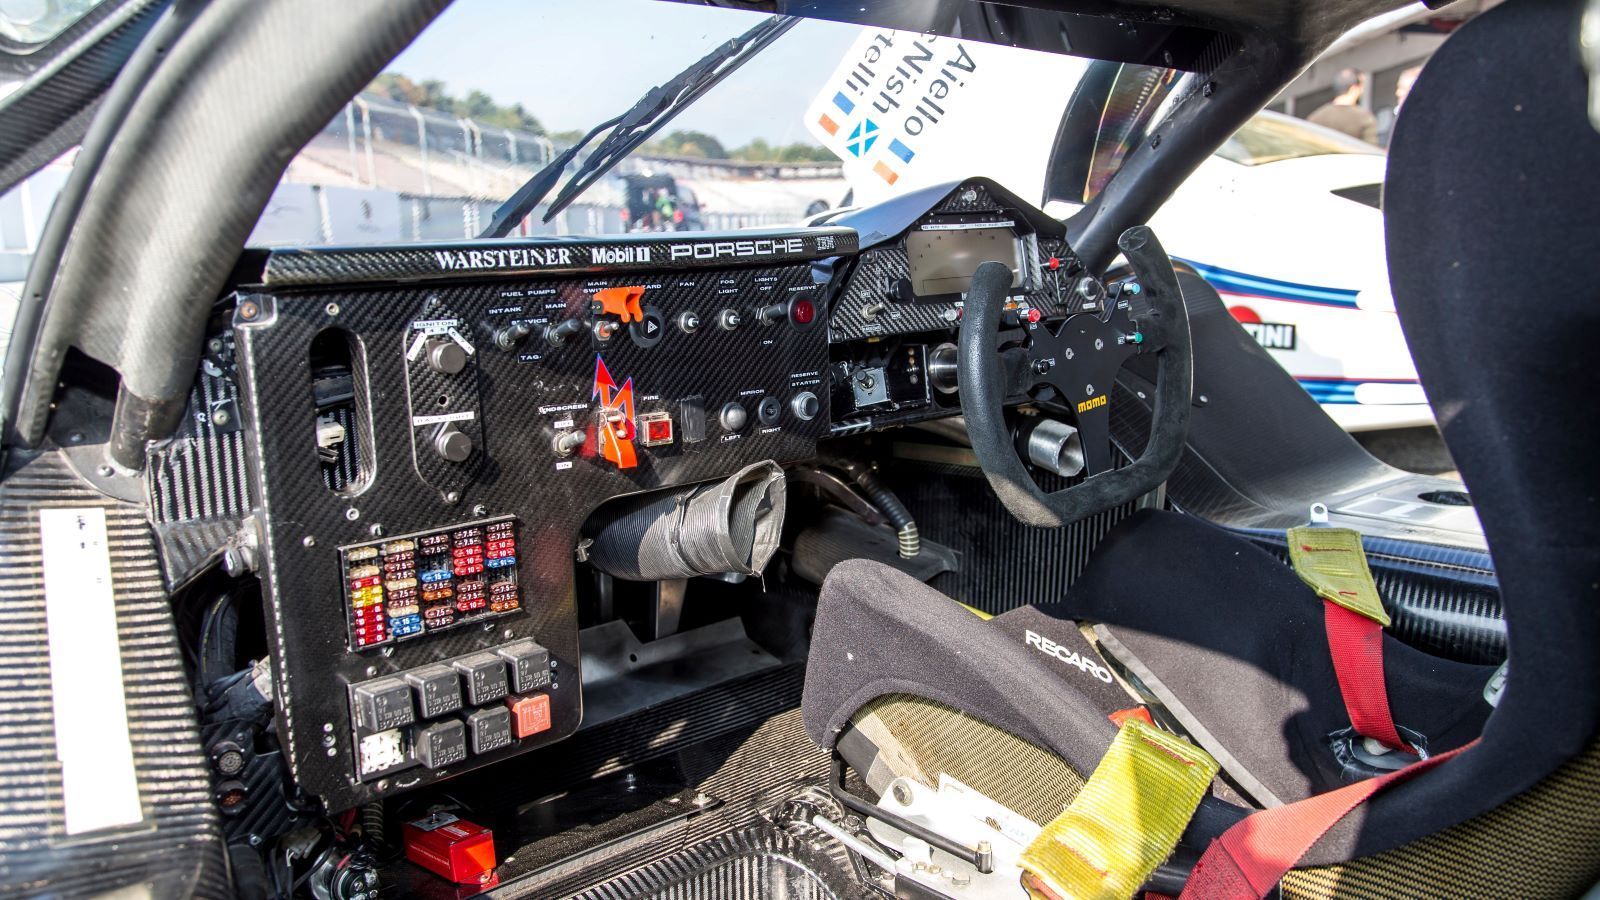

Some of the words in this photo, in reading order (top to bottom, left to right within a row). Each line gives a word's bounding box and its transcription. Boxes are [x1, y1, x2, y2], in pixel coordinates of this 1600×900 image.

[846, 30, 895, 96] telli
[904, 43, 977, 136] Aiello
[592, 247, 634, 265] Mobil
[670, 239, 803, 260] PORSCHE
[434, 248, 571, 270] WARSTEINER
[511, 317, 548, 325] SVICE
[791, 370, 819, 378] RESERVE
[791, 379, 820, 387] STARTER
[761, 426, 781, 434] RIGHT
[400, 590, 408, 598] 7.5
[1025, 629, 1113, 683] RECARO
[477, 688, 508, 703] BOSCH
[428, 701, 462, 715] BOSCH
[480, 736, 511, 752] BOSCH
[433, 752, 465, 768] BOSCH
